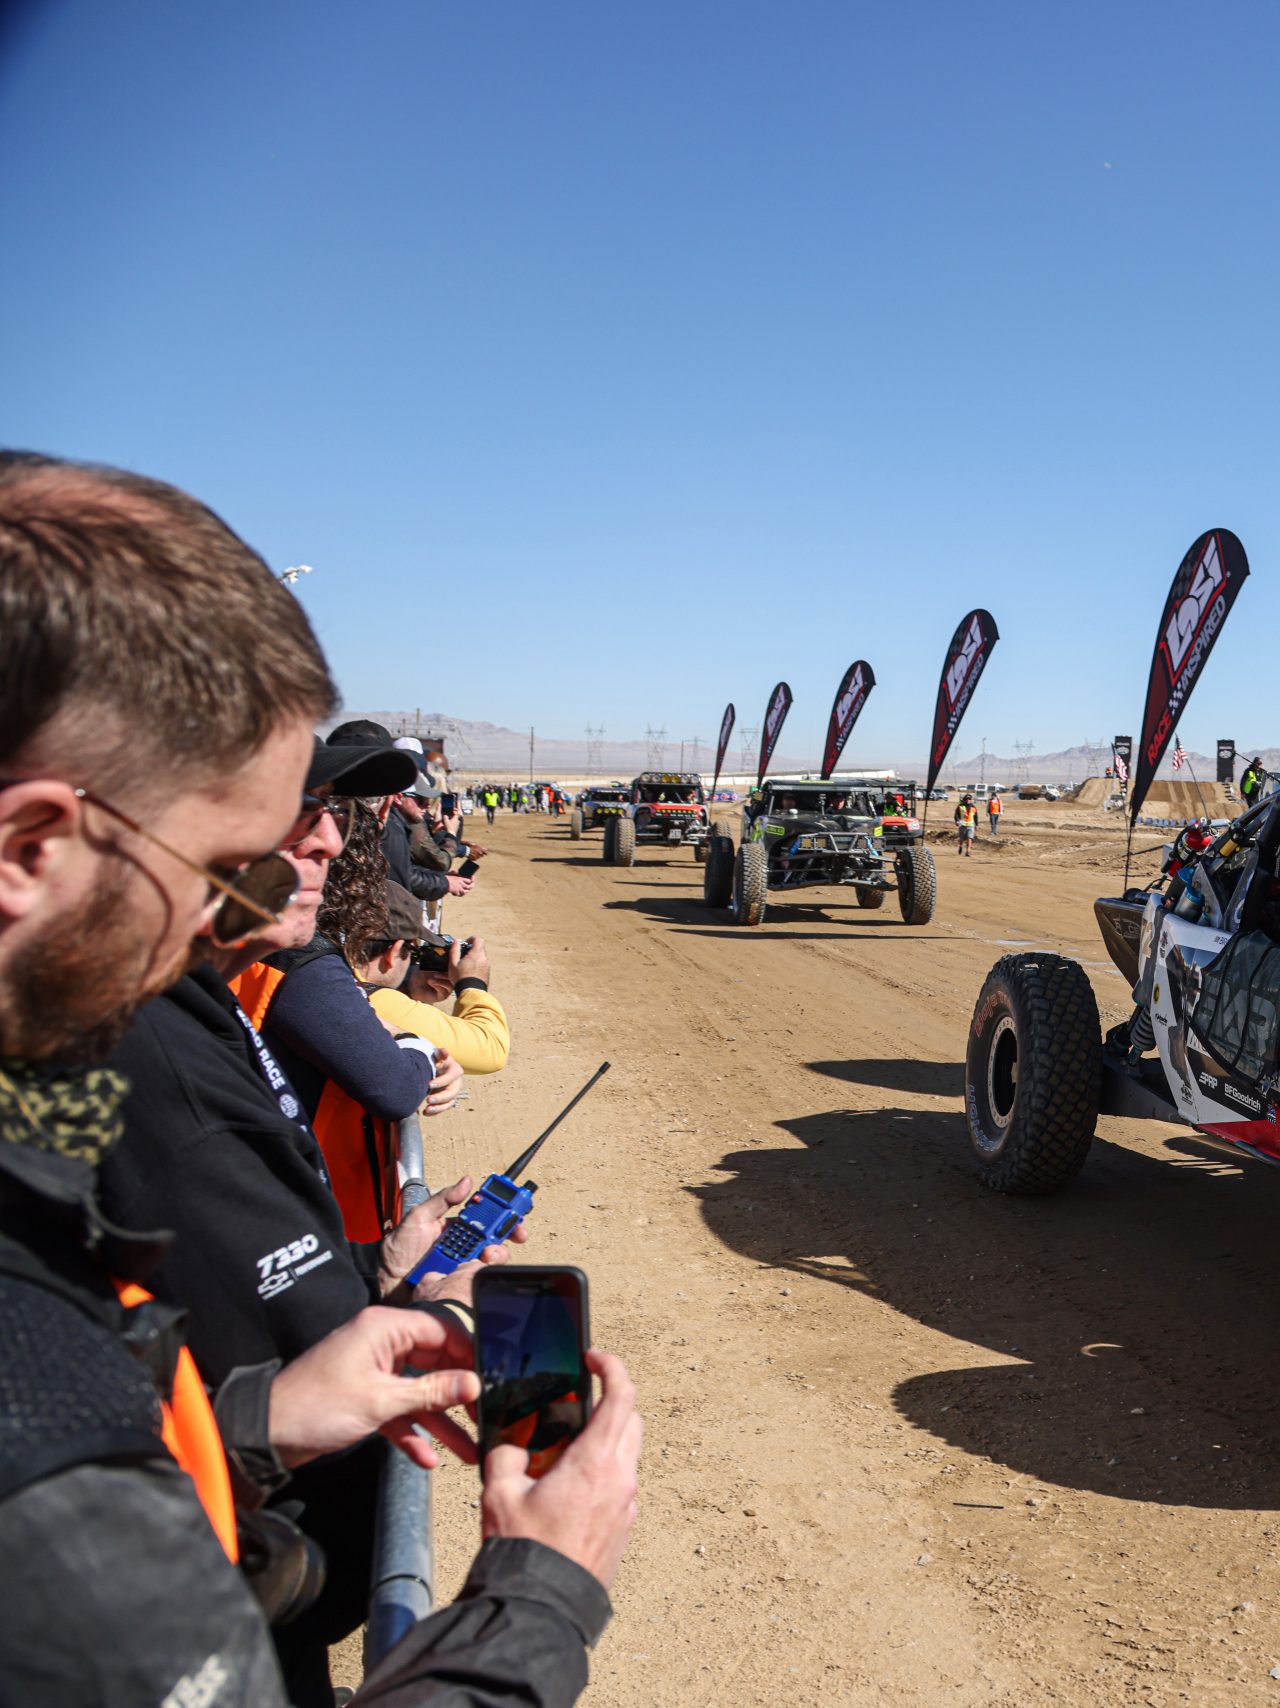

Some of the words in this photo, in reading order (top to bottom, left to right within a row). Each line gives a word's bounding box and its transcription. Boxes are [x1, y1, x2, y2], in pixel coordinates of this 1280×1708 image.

[1165, 535, 1223, 672] LOSI
[1147, 708, 1172, 766] RACE
[1181, 594, 1226, 691] INSPIRED
[259, 1049, 286, 1090] RACE
[1224, 1083, 1261, 1110] BFGoodrich
